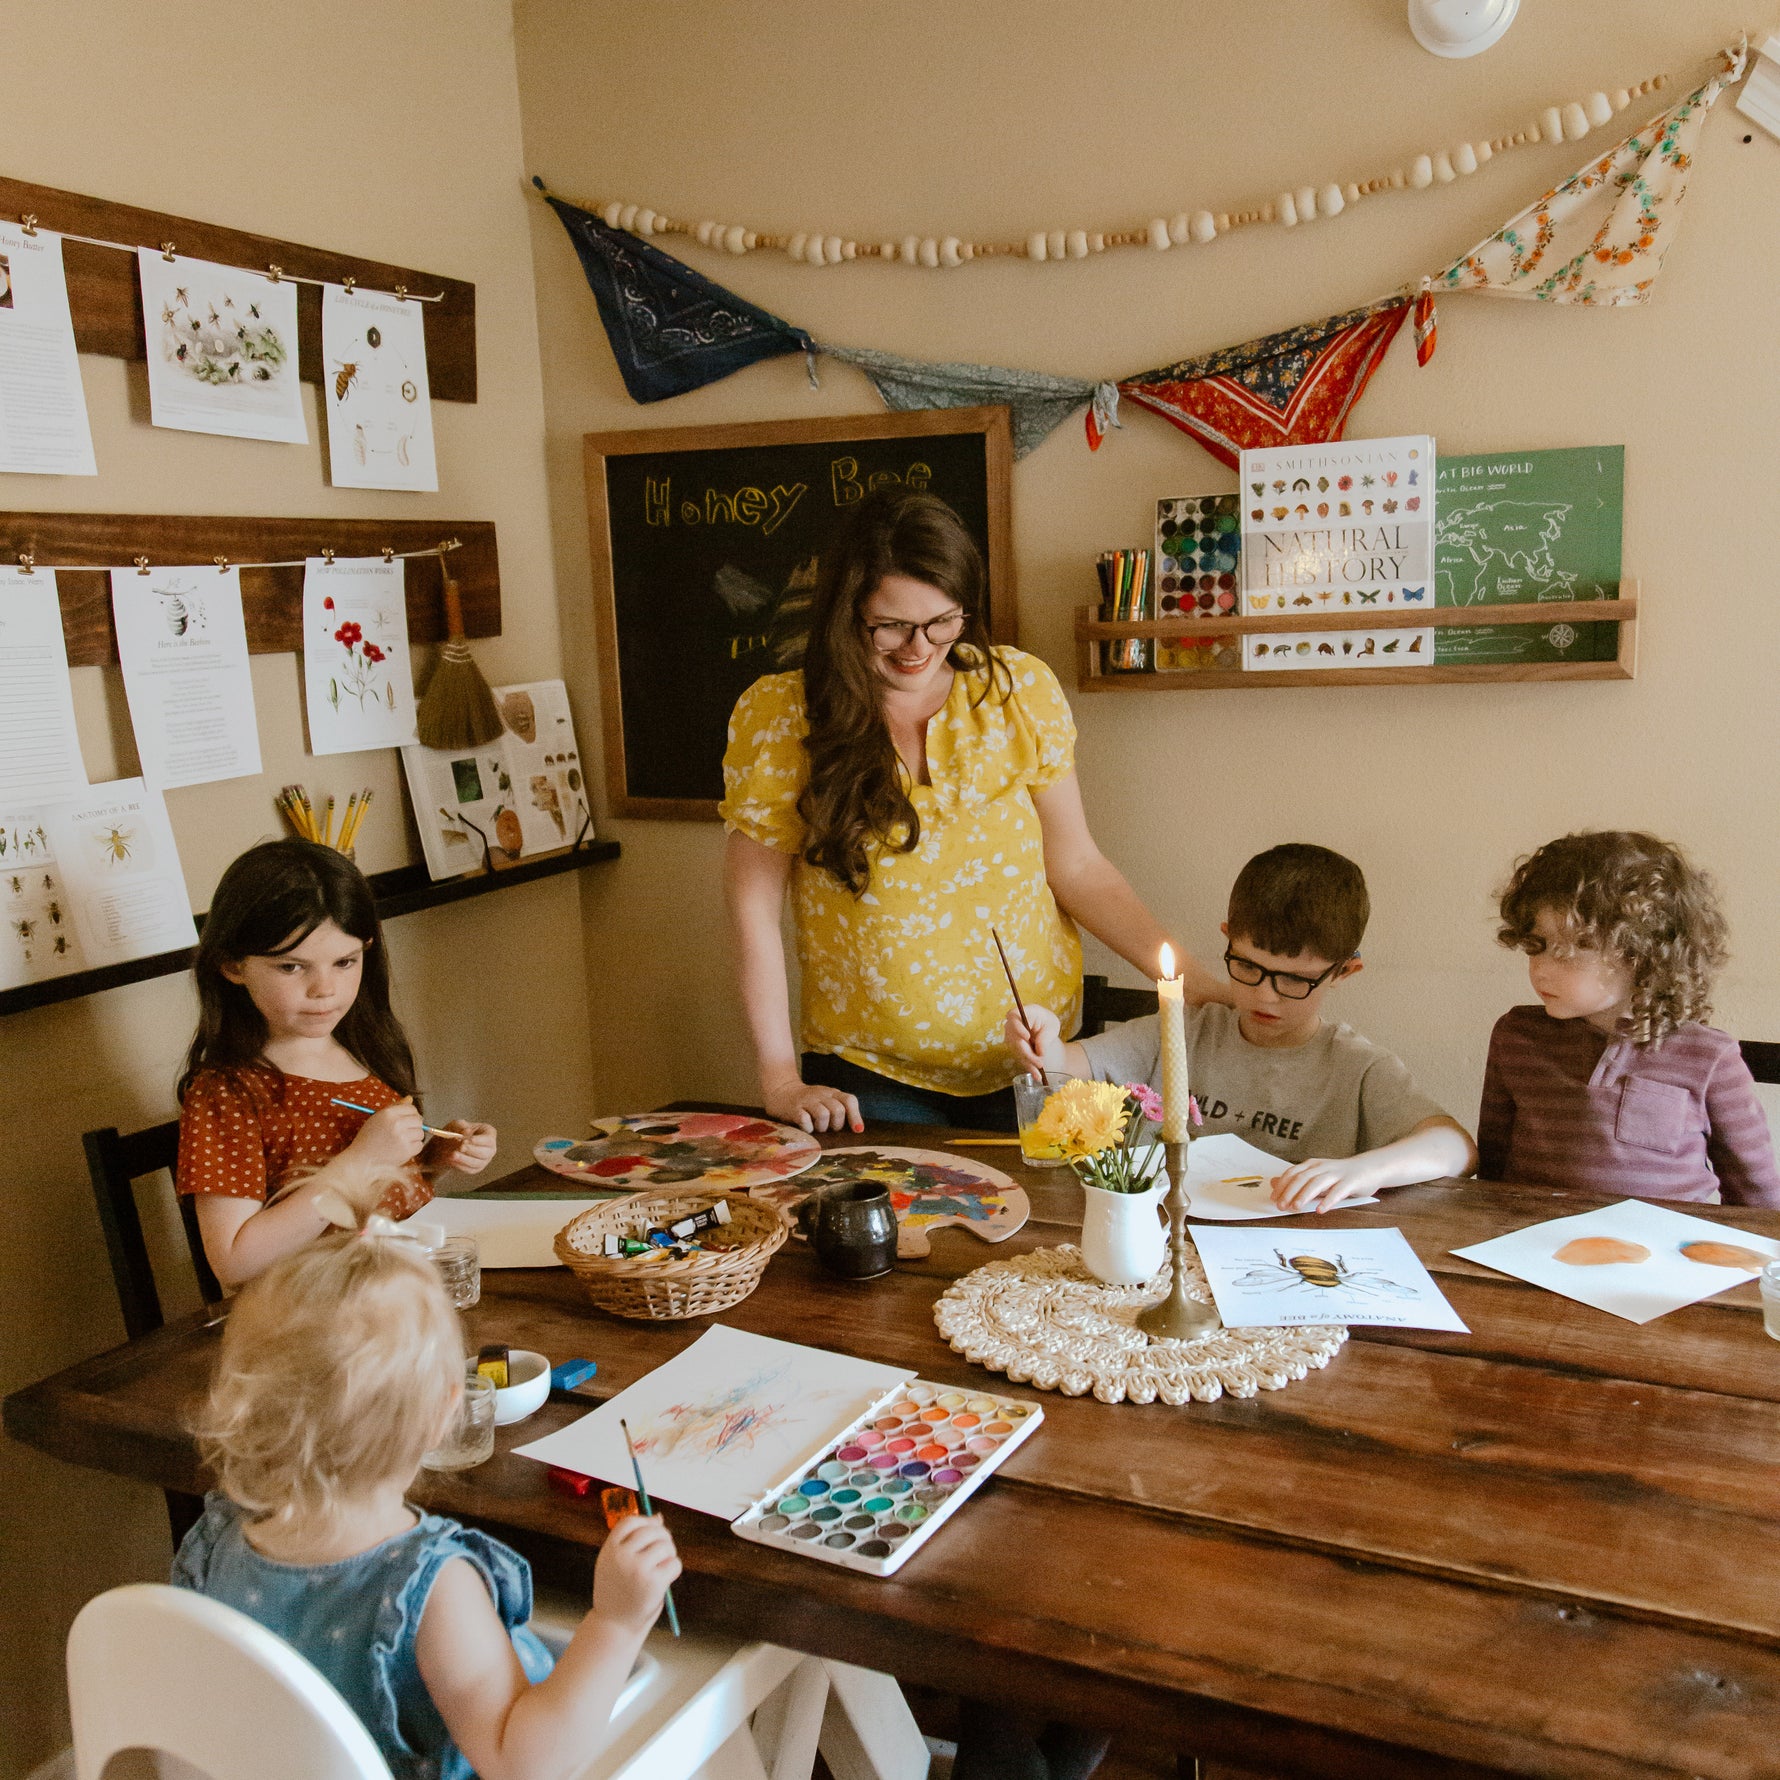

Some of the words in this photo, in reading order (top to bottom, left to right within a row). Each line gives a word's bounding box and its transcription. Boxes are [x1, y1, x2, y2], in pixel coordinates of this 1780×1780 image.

[1276, 452, 1398, 470] SMITHSONIAN
[1439, 470, 1456, 480] AT
[1461, 464, 1484, 478] BIG
[1487, 462, 1533, 475] WORLD
[645, 476, 808, 535] Honey
[1264, 526, 1409, 557] NATURAL
[1265, 556, 1407, 587] HISTORY
[1251, 1110, 1303, 1141] FREE
[1331, 1312, 1407, 1322] ANATOMY
